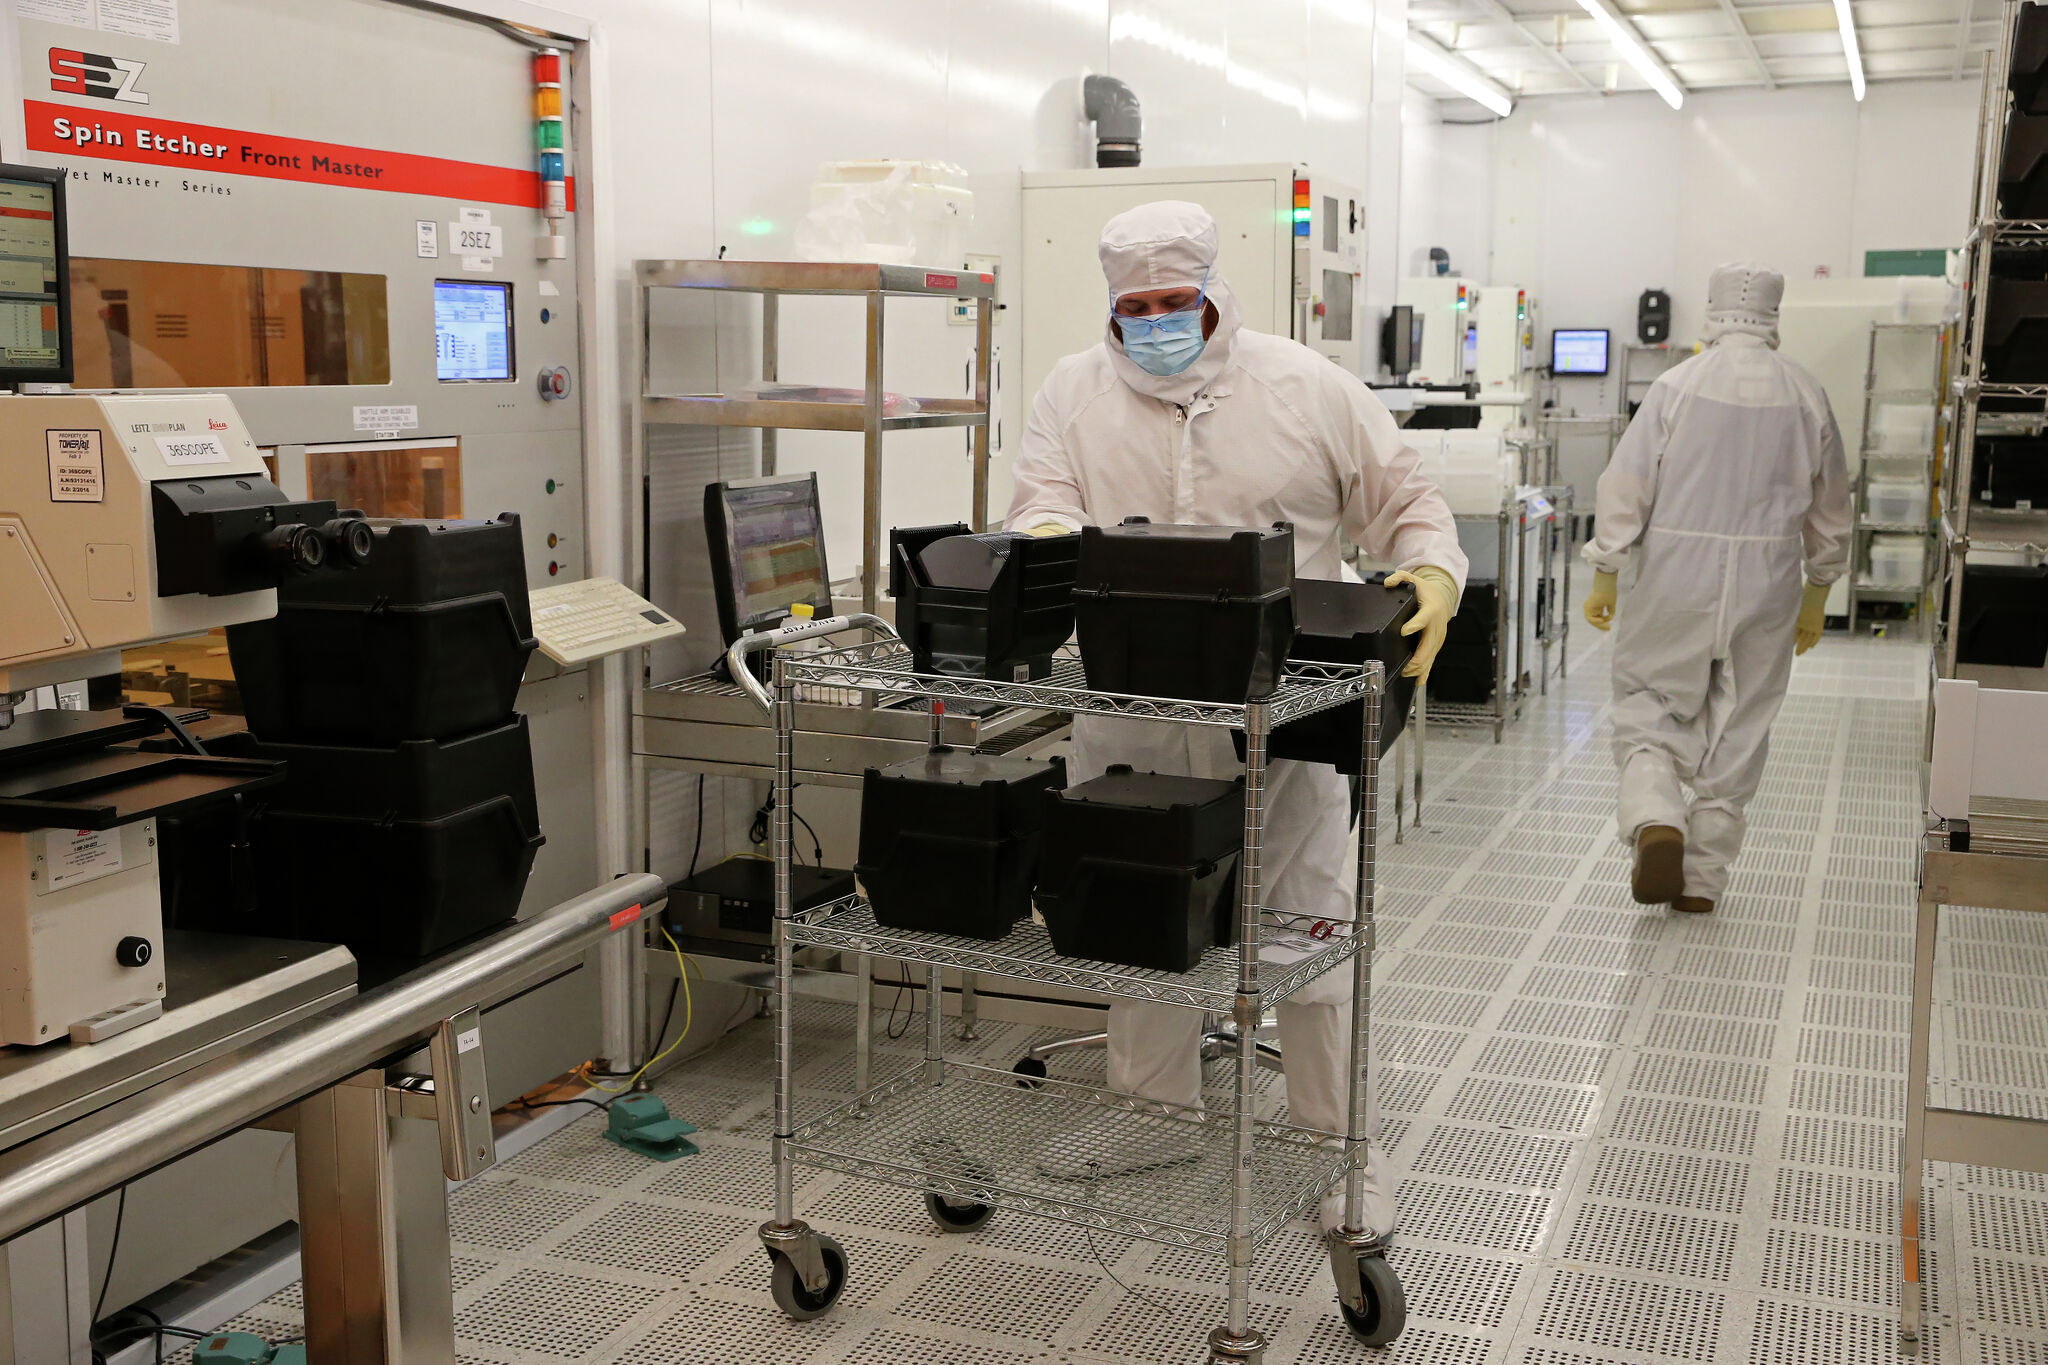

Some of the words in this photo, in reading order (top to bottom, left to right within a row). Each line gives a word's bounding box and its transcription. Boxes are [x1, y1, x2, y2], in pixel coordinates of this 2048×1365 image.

[49, 46, 150, 105] SEZ
[53, 117, 124, 148] Spin
[136, 128, 228, 159] Etcher
[241, 145, 301, 169] Front
[312, 155, 384, 179] Master
[103, 171, 160, 188] Master
[182, 180, 232, 196] Series
[460, 230, 492, 249] 2SEZ
[131, 424, 151, 433] LEITZ
[152, 423, 186, 433] PLAN
[208, 418, 229, 430] Leica
[167, 442, 218, 456] 36SCOPE
